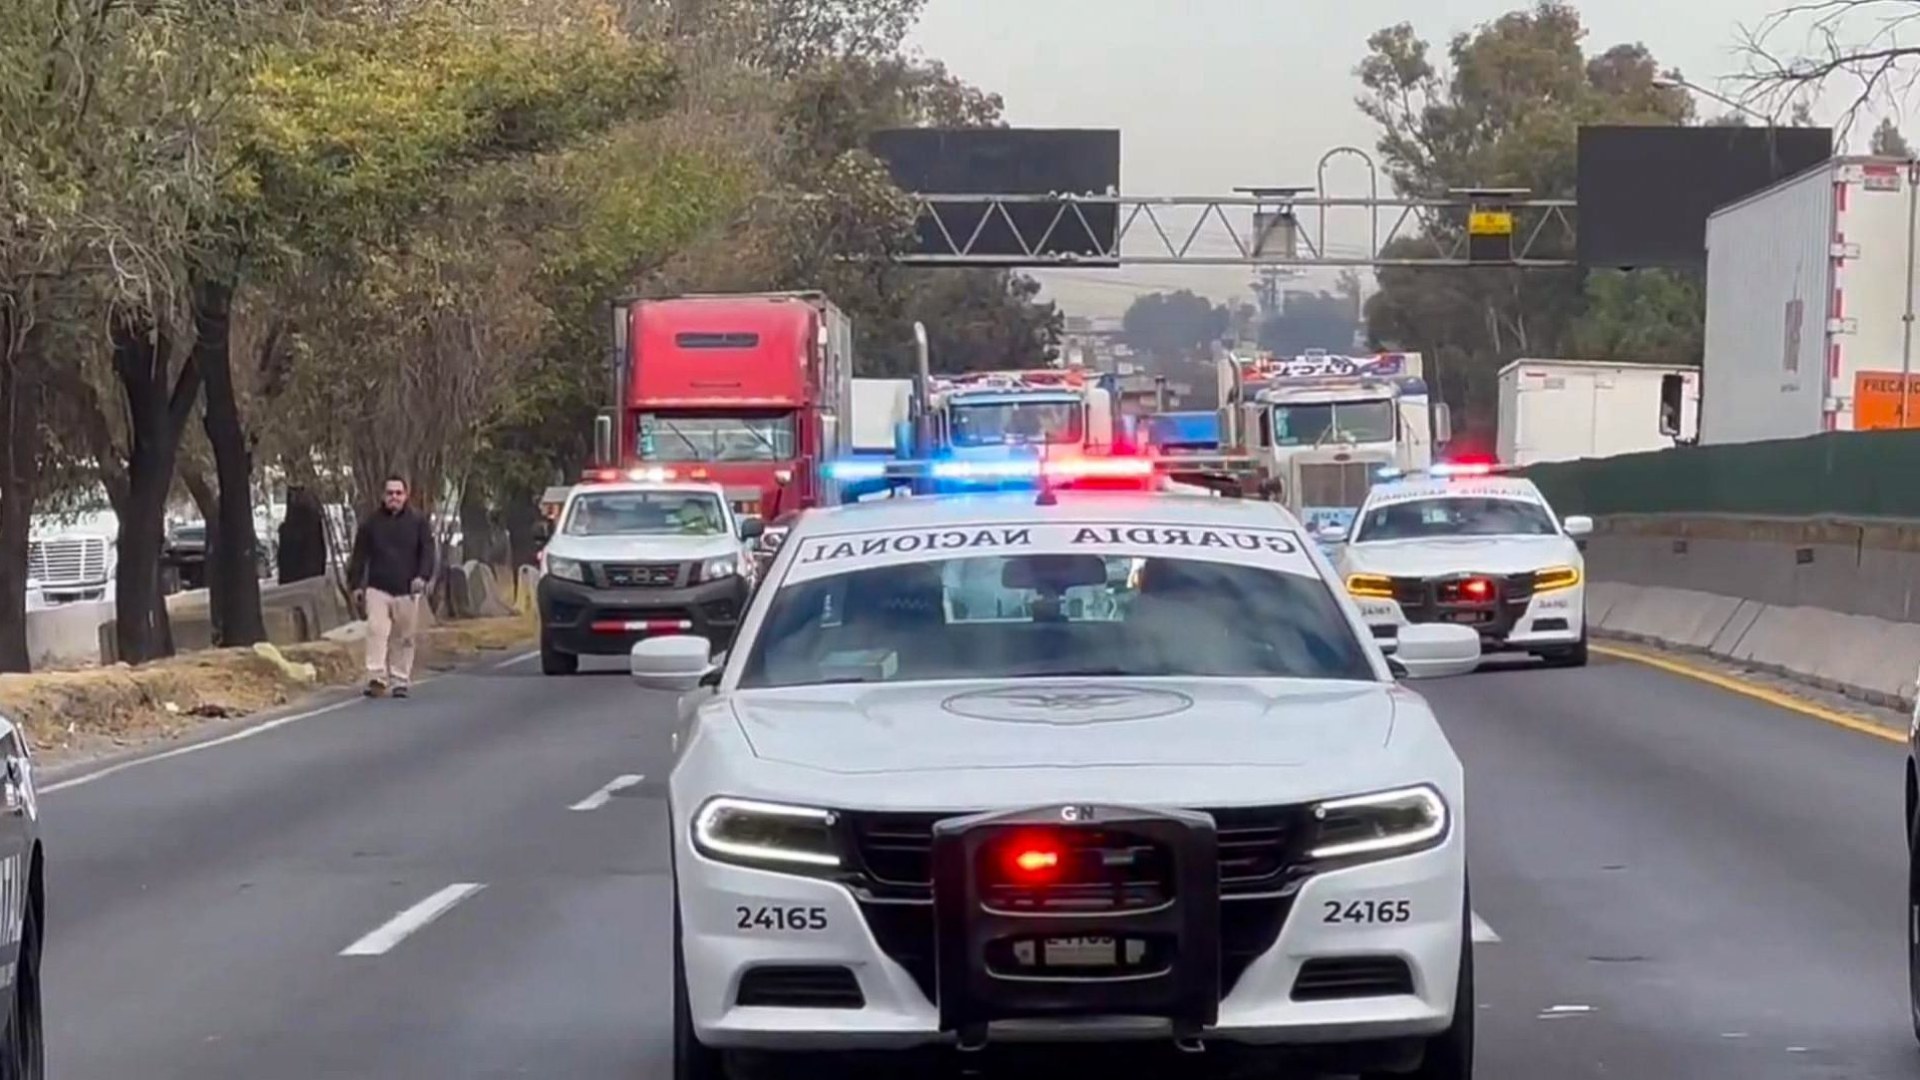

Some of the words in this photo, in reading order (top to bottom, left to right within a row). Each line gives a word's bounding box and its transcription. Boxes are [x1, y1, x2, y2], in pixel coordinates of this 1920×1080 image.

[1061, 806, 1094, 821] GN
[736, 906, 828, 930] 24165
[1323, 900, 1410, 923] 24165
